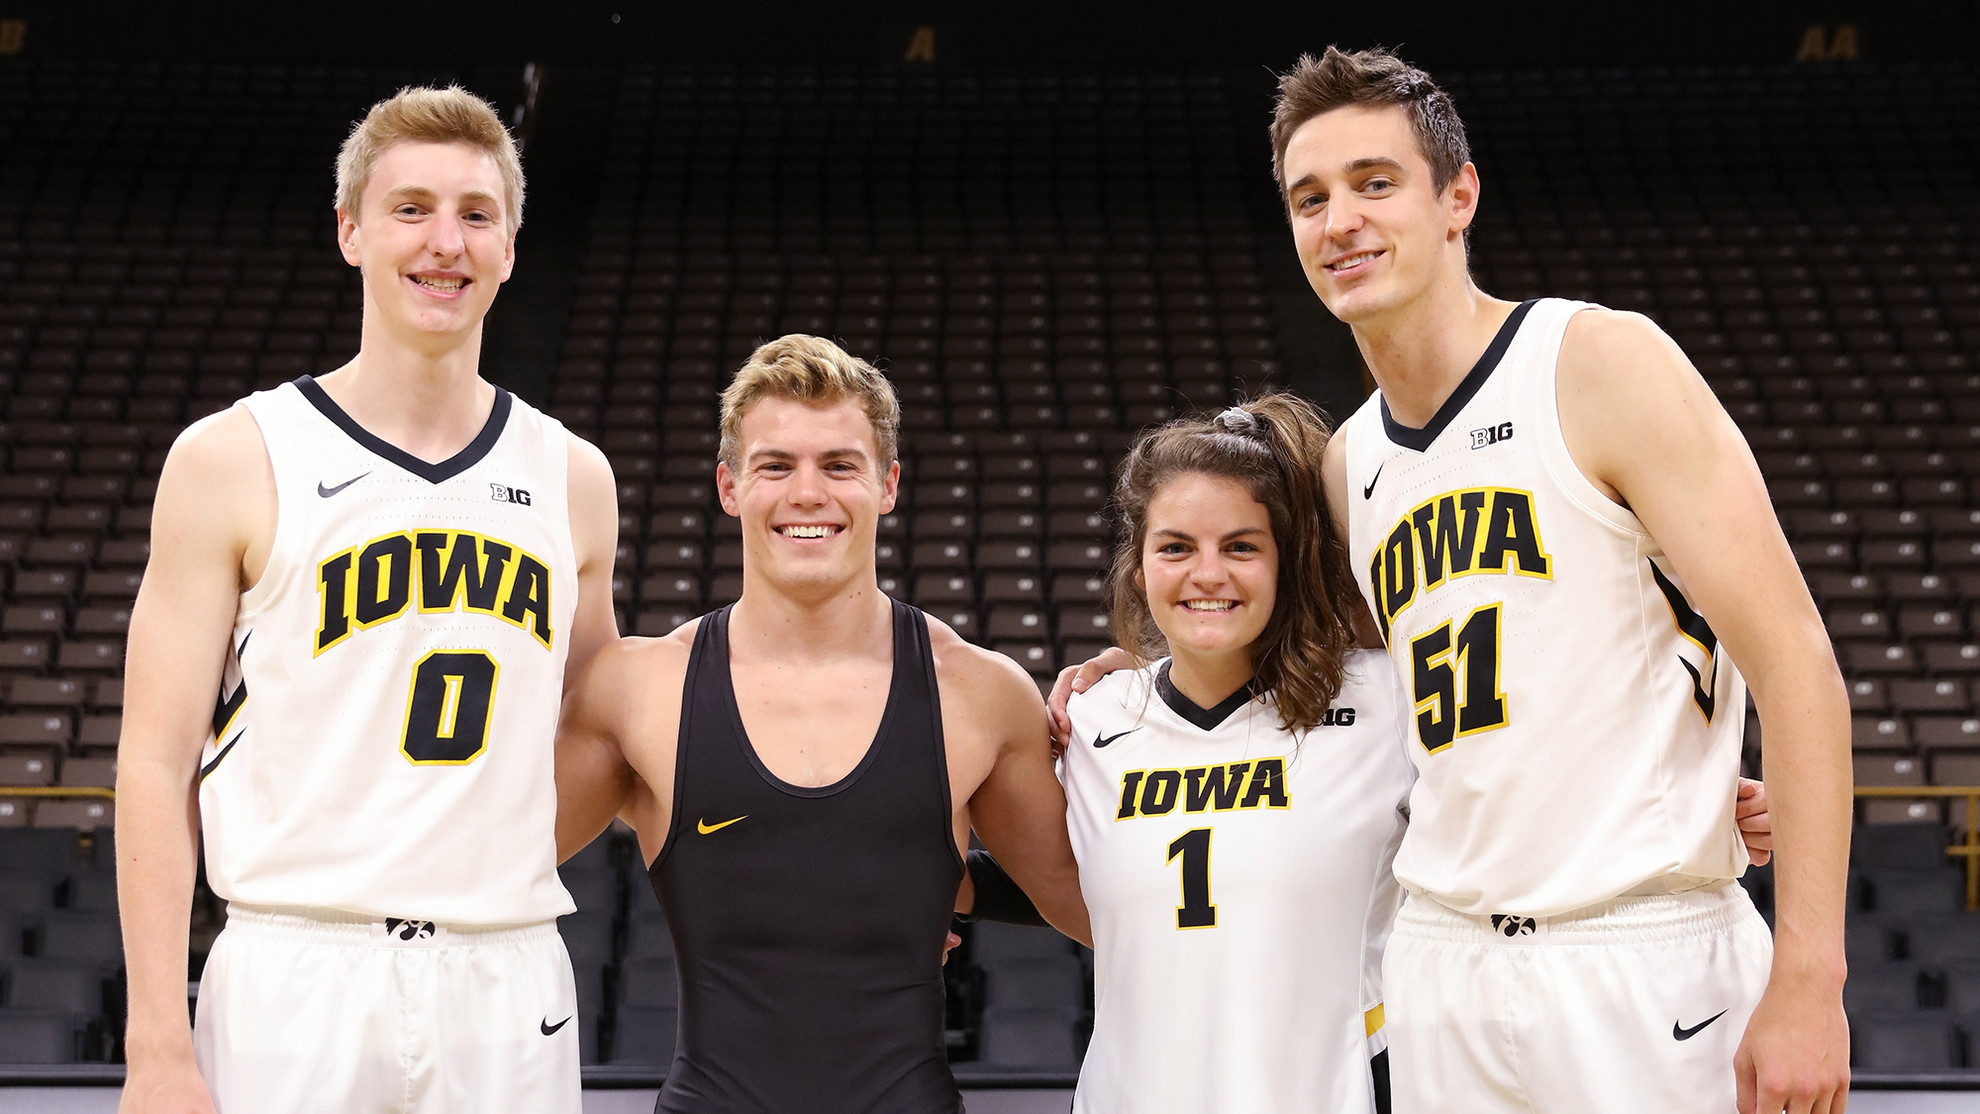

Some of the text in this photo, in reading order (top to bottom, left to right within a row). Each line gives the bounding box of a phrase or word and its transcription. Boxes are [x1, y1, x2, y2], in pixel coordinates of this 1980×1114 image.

[904, 25, 936, 63] A
[1795, 24, 1859, 63] AA
[312, 528, 555, 660] IOWA
[1370, 486, 1554, 657] IOWA
[399, 648, 501, 767] 0
[1410, 600, 1510, 757] 51
[1114, 755, 1292, 822] IOWA
[1165, 825, 1218, 931] 1
